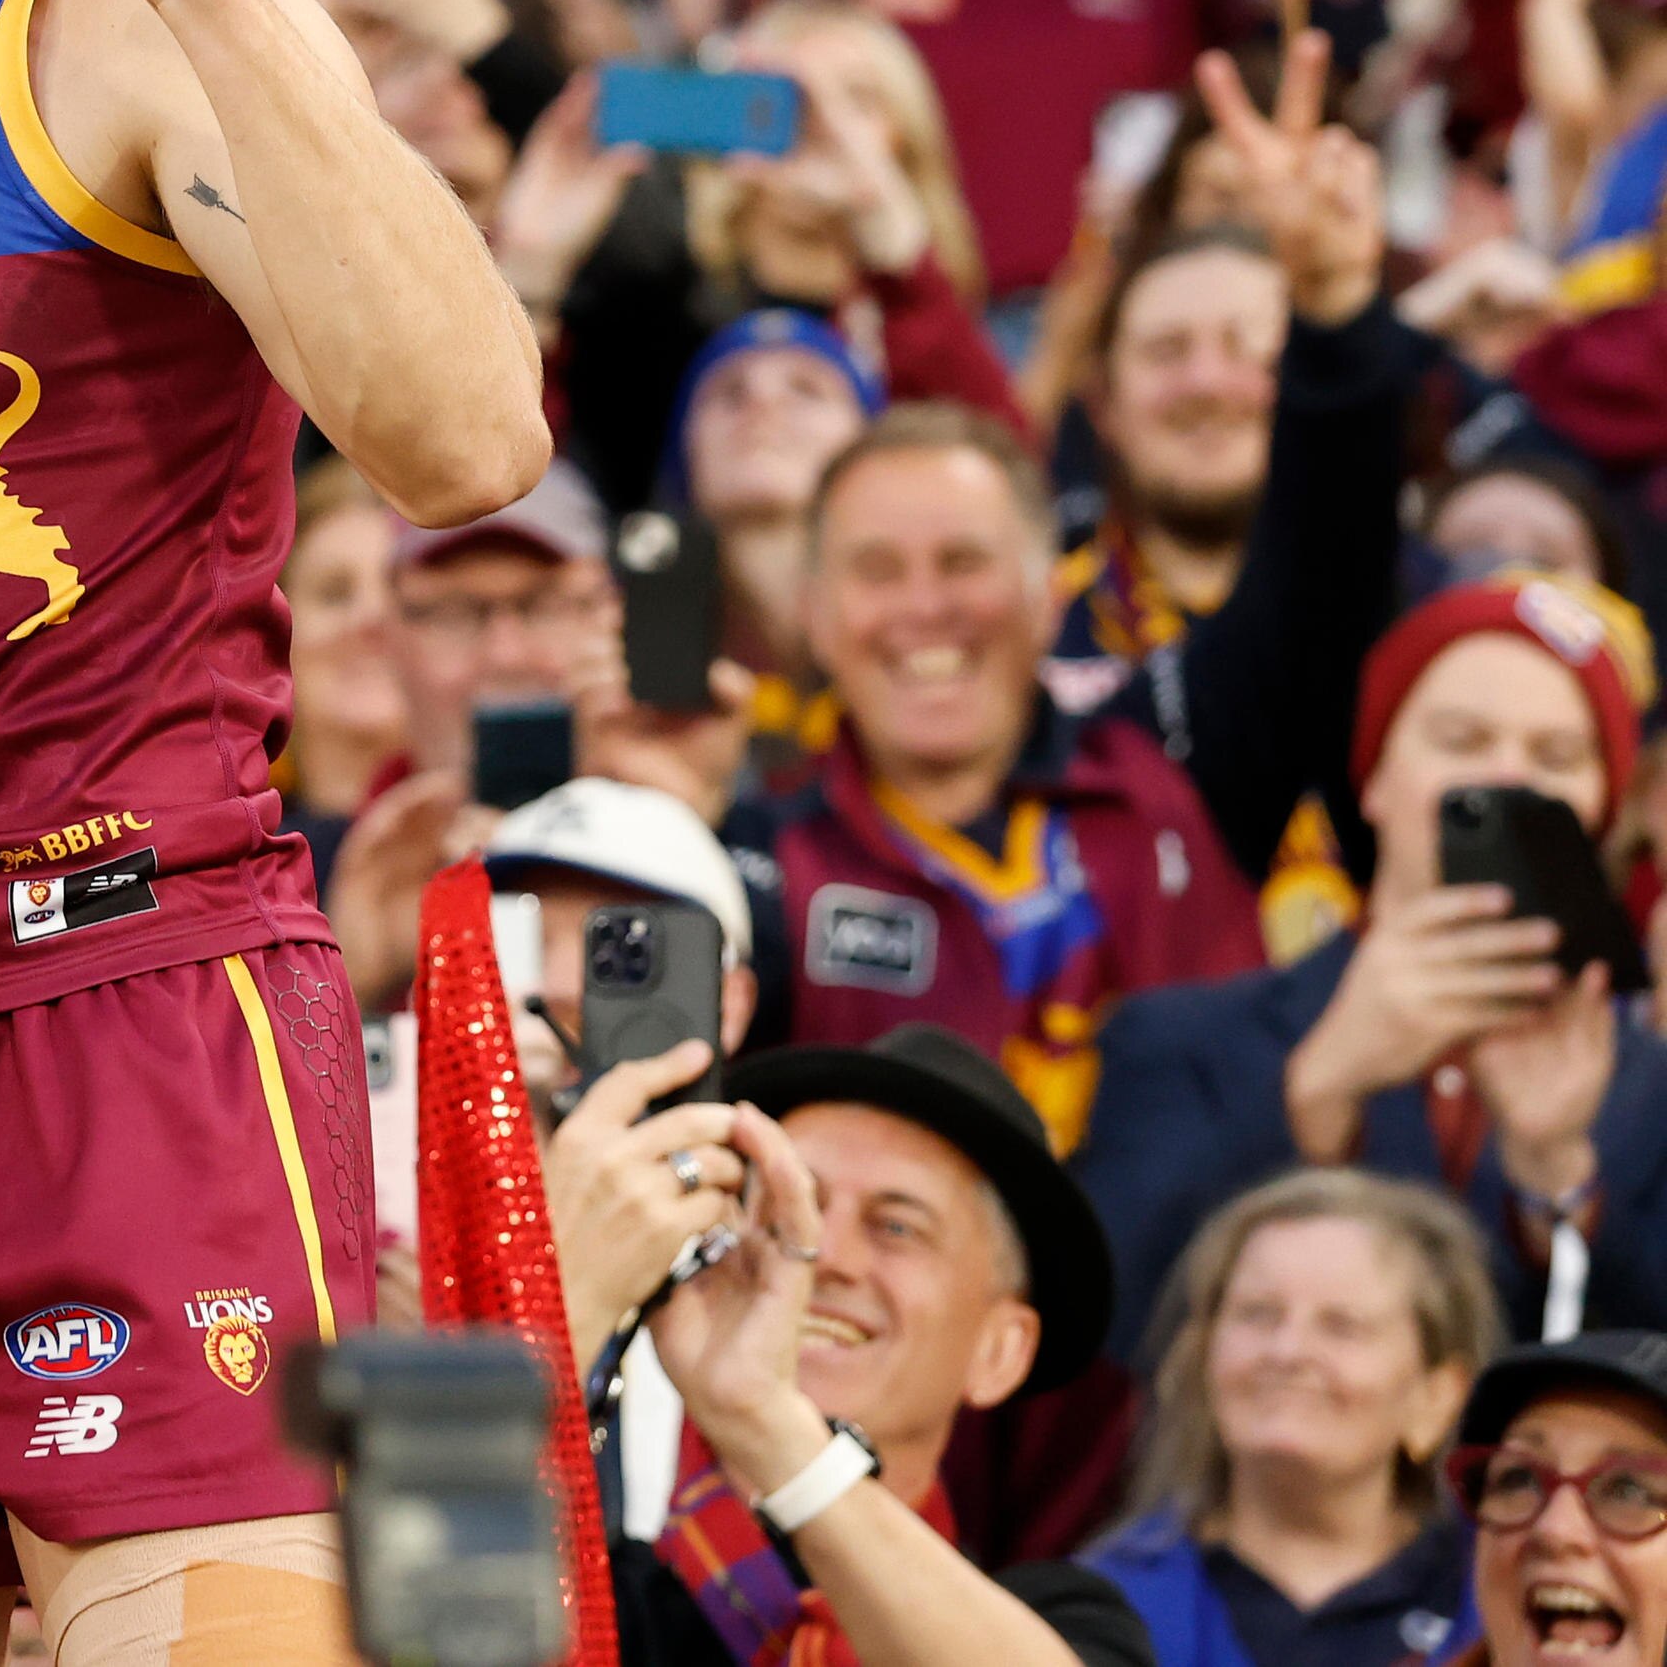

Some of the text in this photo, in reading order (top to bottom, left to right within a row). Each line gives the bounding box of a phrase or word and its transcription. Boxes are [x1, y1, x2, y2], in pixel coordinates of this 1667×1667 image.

[38, 810, 153, 862] BBFFC
[25, 910, 55, 923] AFL
[195, 1287, 252, 1302] BRISBANE
[183, 1295, 274, 1329] LIONS
[21, 1317, 116, 1364] AFL
